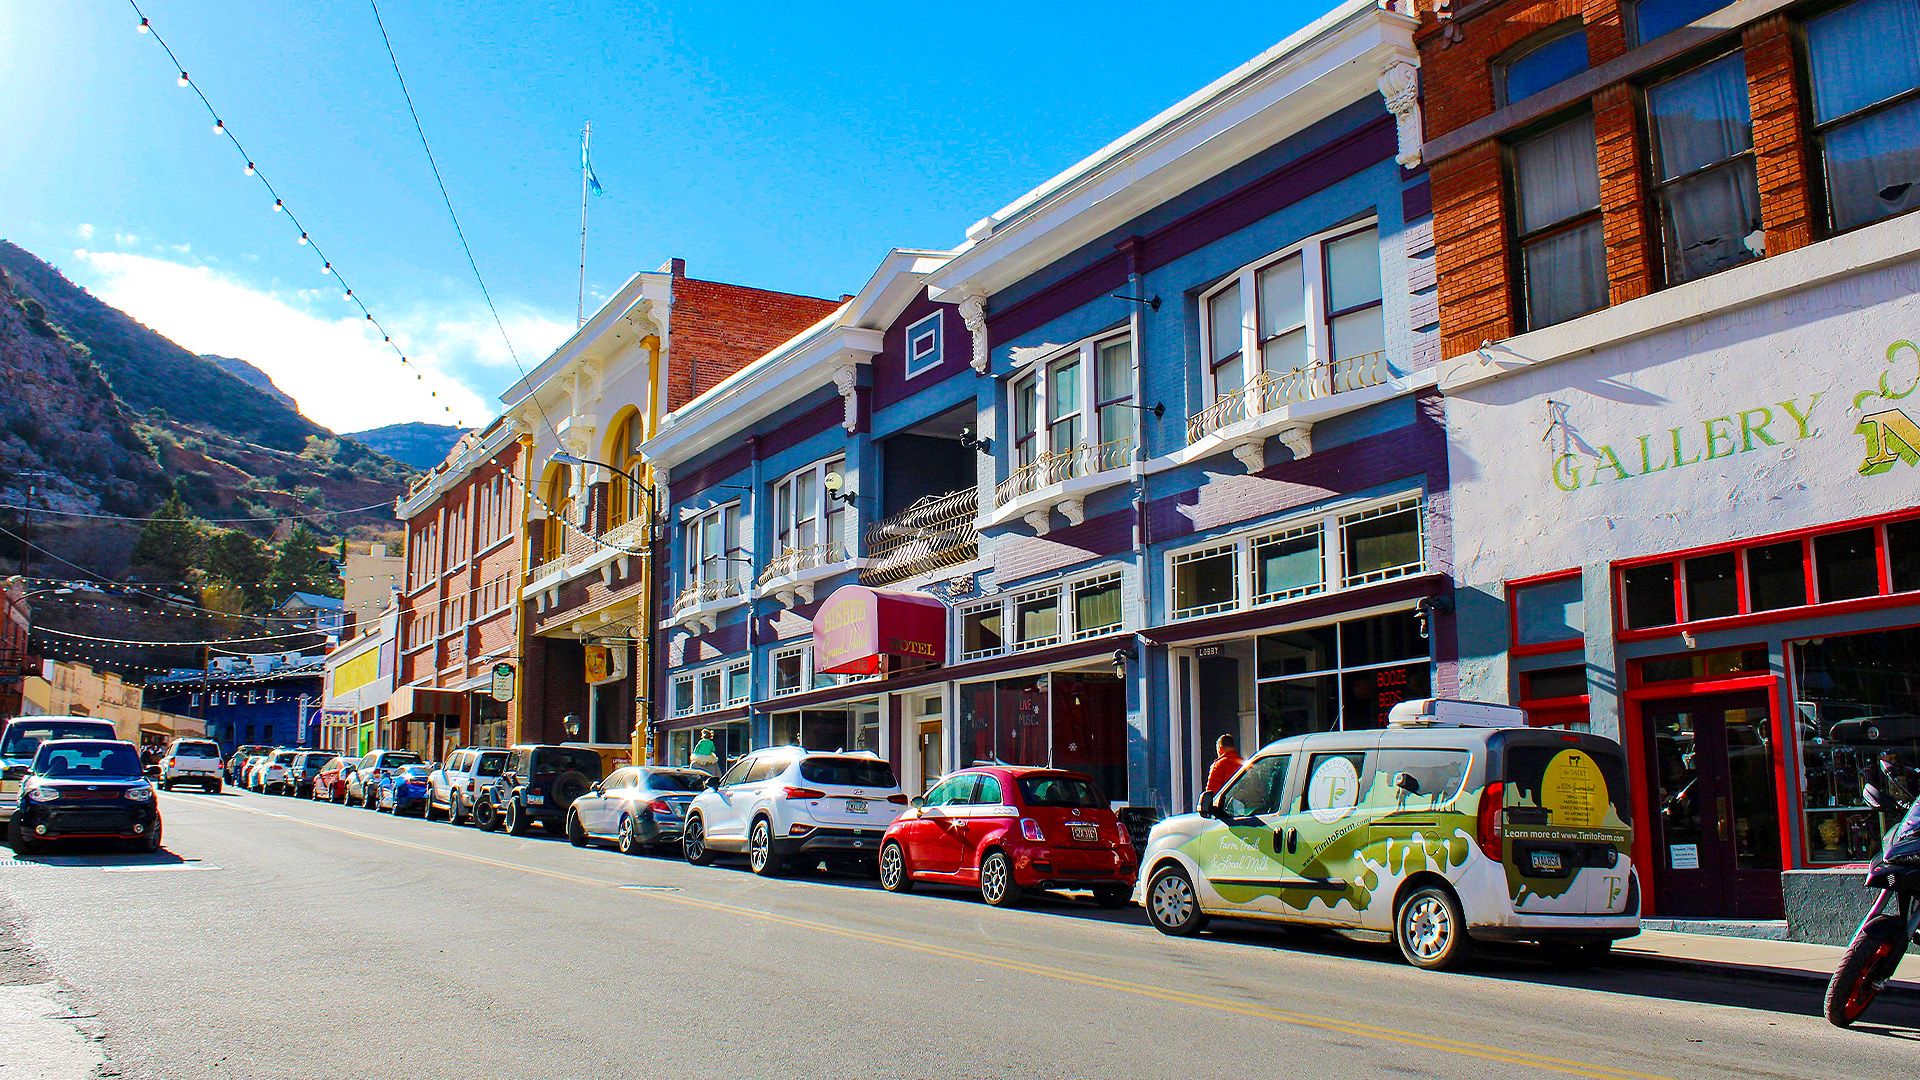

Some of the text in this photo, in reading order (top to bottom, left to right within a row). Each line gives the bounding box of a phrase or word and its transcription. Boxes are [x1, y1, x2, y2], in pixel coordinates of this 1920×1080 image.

[1552, 391, 1825, 492] GALLERY
[823, 599, 866, 633] BISBEE
[1199, 647, 1219, 657] LOBBY
[1377, 668, 1407, 687] BOOZE
[1219, 836, 1260, 851] Farm Fresh
[1302, 816, 1372, 868] www.TirritoFarm.com
[1504, 829, 1625, 842] Learn more at www.TirritoFarm.com
[1217, 854, 1242, 872] Local
[1242, 855, 1268, 872] Milk
